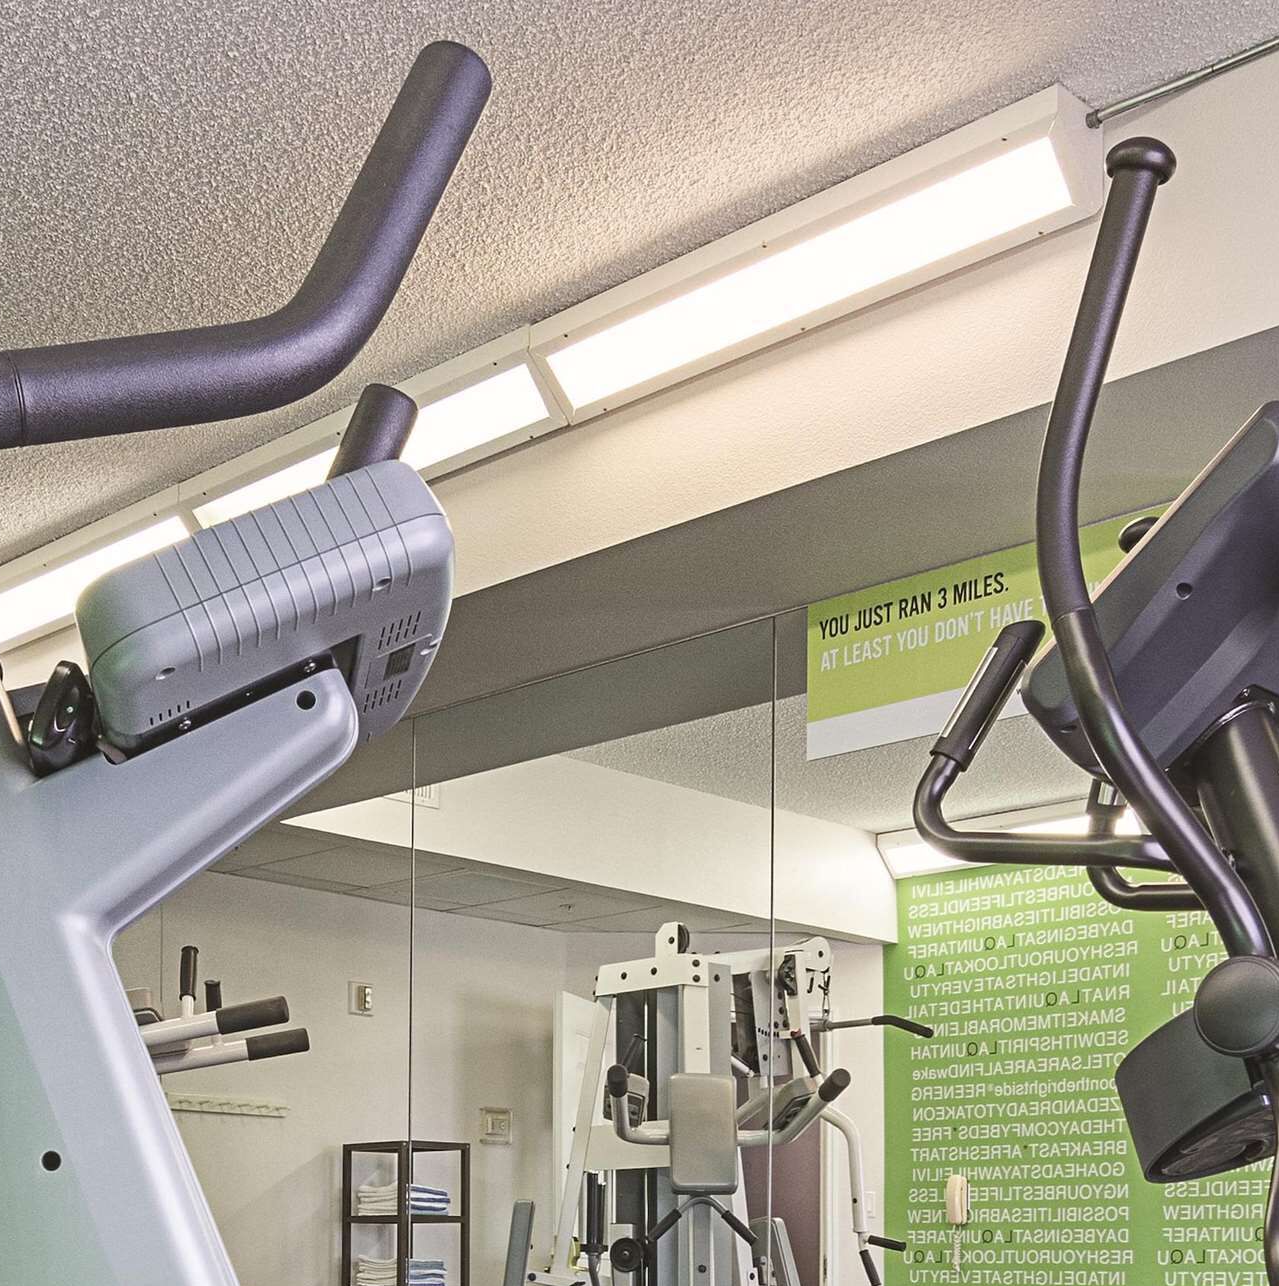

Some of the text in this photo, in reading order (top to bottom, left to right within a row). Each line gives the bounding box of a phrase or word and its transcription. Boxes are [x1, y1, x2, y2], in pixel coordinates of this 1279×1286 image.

[819, 572, 1009, 640] YOU JUST RAN 3 MILES.
[821, 649, 840, 672] AT
[843, 634, 893, 667] LEAST
[896, 625, 929, 652] YOU
[935, 611, 985, 644] DON'T
[990, 598, 1034, 629] HAVE
